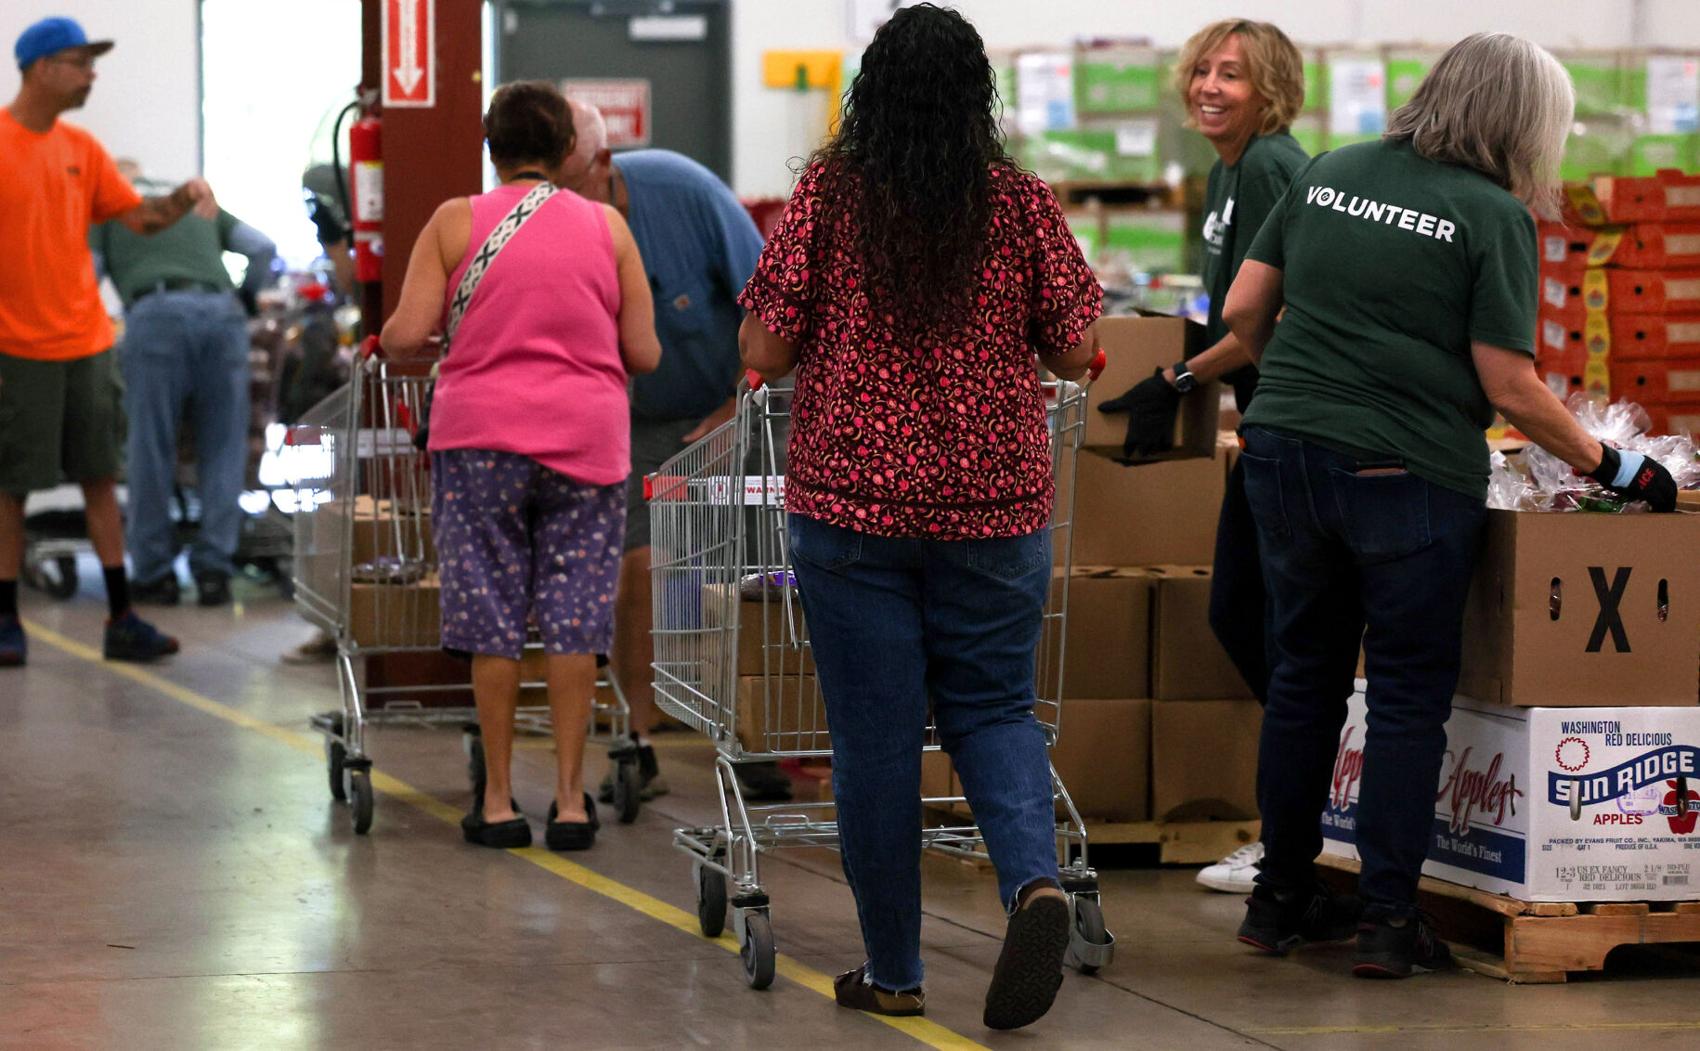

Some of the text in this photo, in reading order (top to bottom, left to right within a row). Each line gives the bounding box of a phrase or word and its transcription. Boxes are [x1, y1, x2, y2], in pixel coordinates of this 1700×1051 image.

[1306, 186, 1456, 242] VOLUNTEER
[1584, 566, 1633, 653] X
[1561, 721, 1621, 734] WASHINGTON
[1605, 733, 1672, 747] RED DELICIOUS
[1617, 750, 1695, 794] RIDGE
[1593, 813, 1644, 826] APPLES
[1436, 834, 1450, 850] The
[1479, 843, 1503, 864] Finest
[1577, 865, 1628, 874] US EX FANCY
[1579, 873, 1596, 882] RED
[1599, 873, 1642, 882] DELICIOUS
